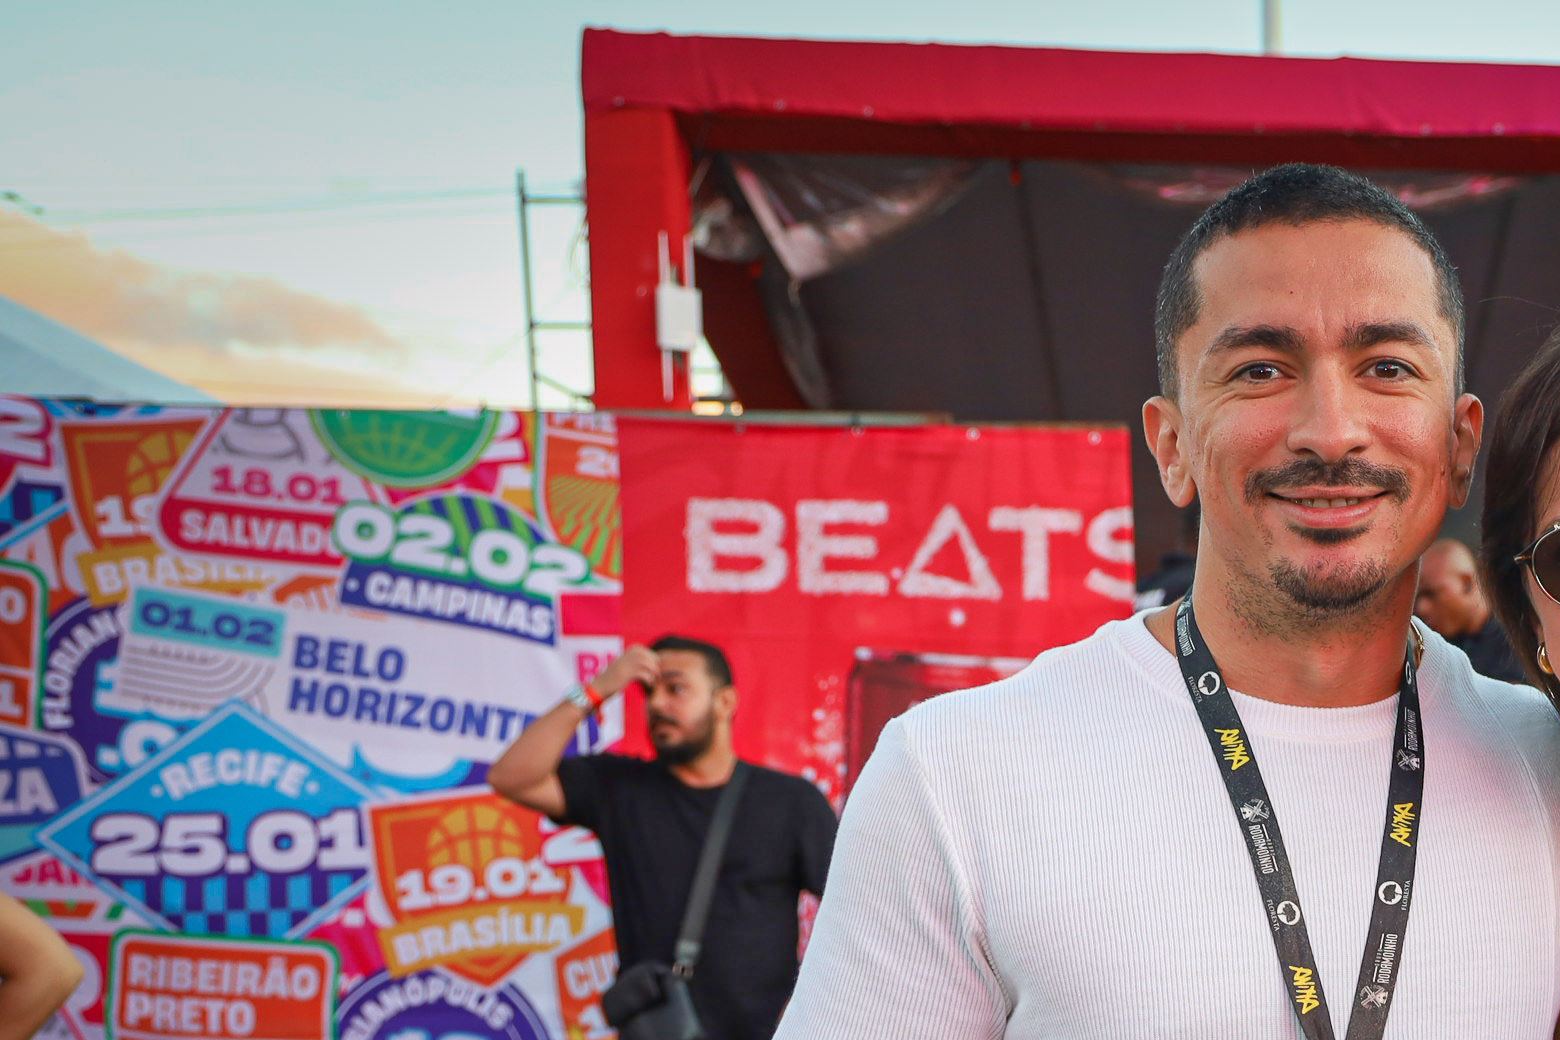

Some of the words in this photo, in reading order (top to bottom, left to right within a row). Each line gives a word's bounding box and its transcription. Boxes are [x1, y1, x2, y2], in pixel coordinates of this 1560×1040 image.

[210, 464, 342, 503] 18.01
[336, 504, 590, 596] 02.02
[686, 496, 1135, 600] BEATS
[142, 603, 274, 646] 01.02
[366, 571, 553, 637] CAMPINAS
[294, 635, 405, 682] BELO
[160, 749, 311, 800] RECIFE
[91, 811, 367, 876] 25.01
[1248, 824, 1275, 874] RODAMOINHO
[394, 857, 567, 910] 19.01
[1401, 880, 1411, 911] FLORESTA
[392, 905, 572, 965] BRASÍLIA
[1266, 899, 1280, 932] FLORESTA
[127, 952, 320, 1000] RIBEIRÃO
[1377, 933, 1399, 984] RODAMOINHO
[124, 991, 256, 1036] PRETO
